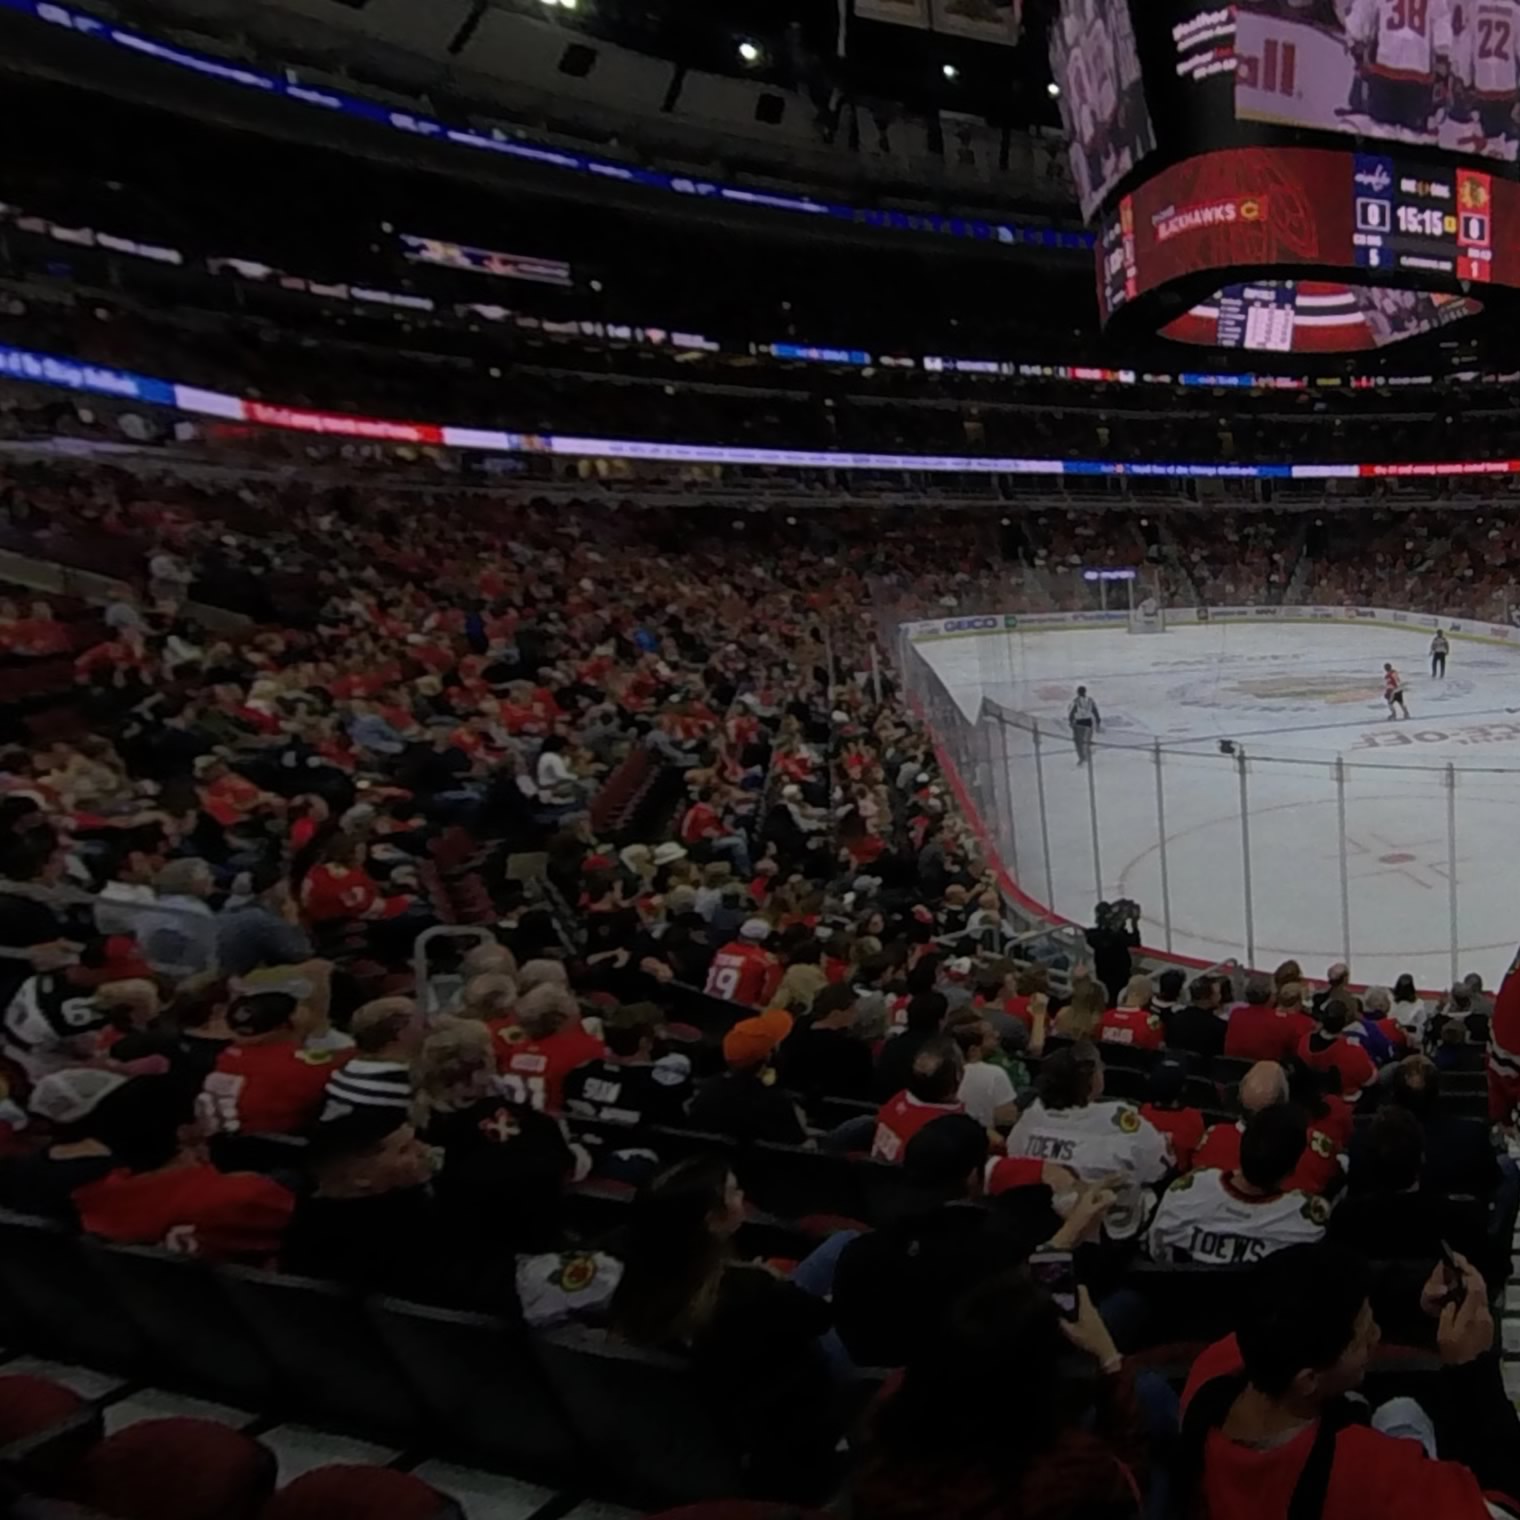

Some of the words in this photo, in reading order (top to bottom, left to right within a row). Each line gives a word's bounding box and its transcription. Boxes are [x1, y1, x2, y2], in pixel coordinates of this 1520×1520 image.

[1478, 19, 1511, 61] 22
[1397, 205, 1443, 236] 15:15
[943, 615, 999, 633] GEICO
[1025, 1135, 1077, 1161] TOEWS
[1190, 1226, 1266, 1265] TOEWS
